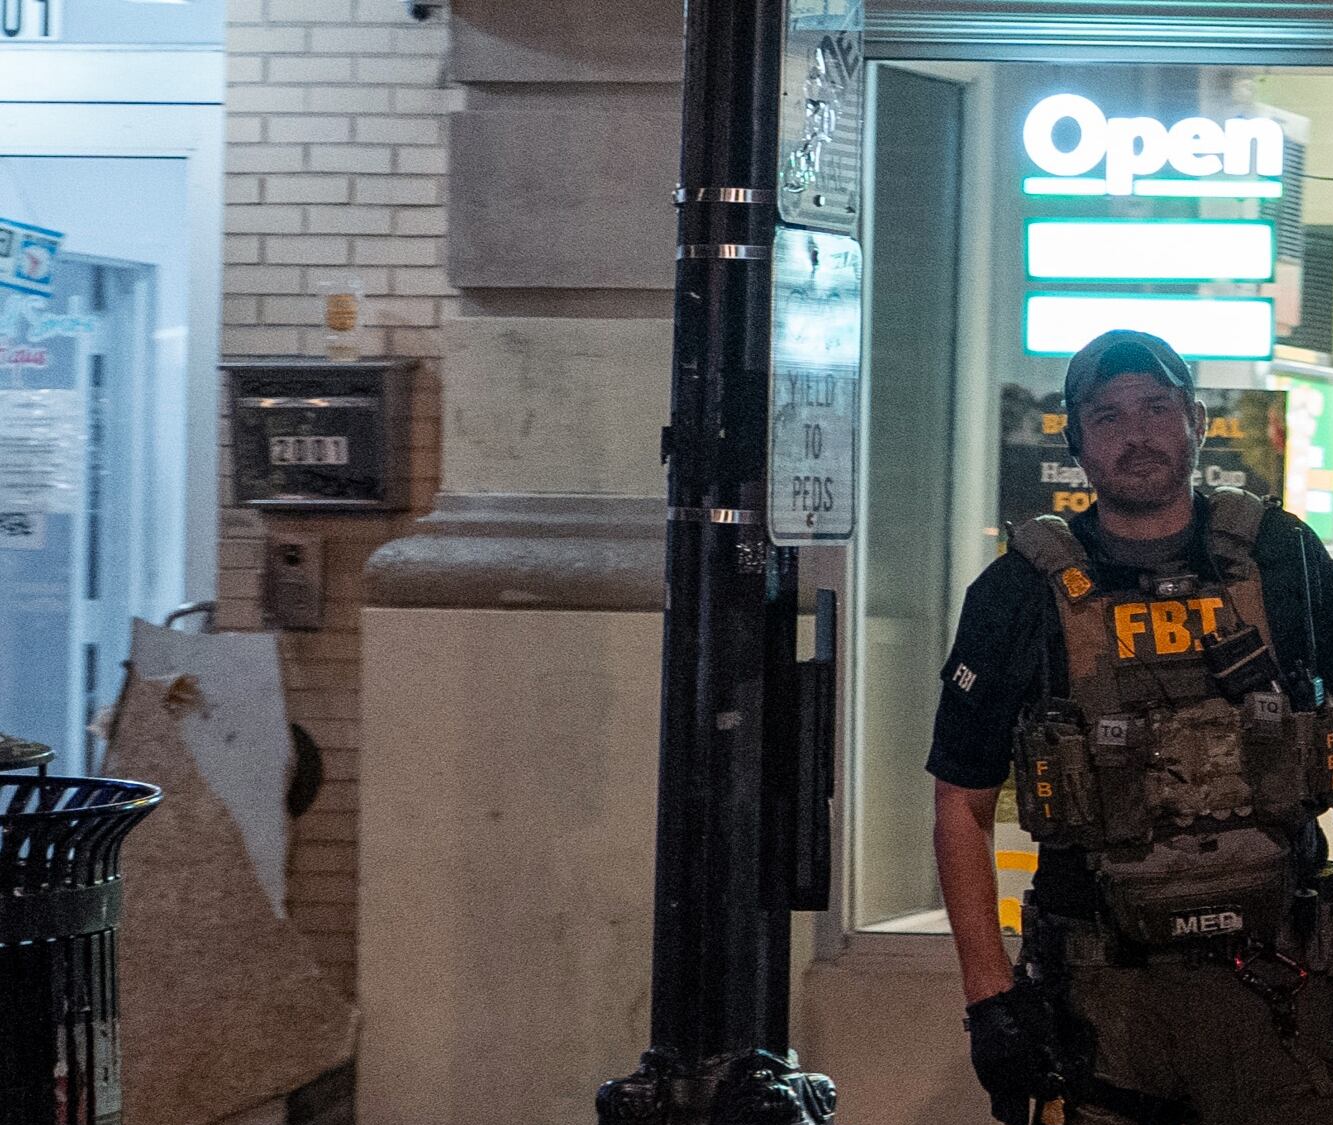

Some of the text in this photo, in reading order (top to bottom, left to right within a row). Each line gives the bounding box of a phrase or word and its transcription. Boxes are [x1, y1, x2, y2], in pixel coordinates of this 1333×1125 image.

[1023, 93, 1284, 196] Open
[788, 369, 836, 408] YIELD
[272, 438, 345, 463] 2001
[803, 423, 823, 460] TO
[791, 475, 834, 513] PEDS
[952, 662, 978, 692] FBI
[1259, 701, 1279, 714] TQ
[1102, 725, 1124, 739] TQ
[1036, 760, 1053, 818] FBI
[1172, 912, 1239, 937] MED
